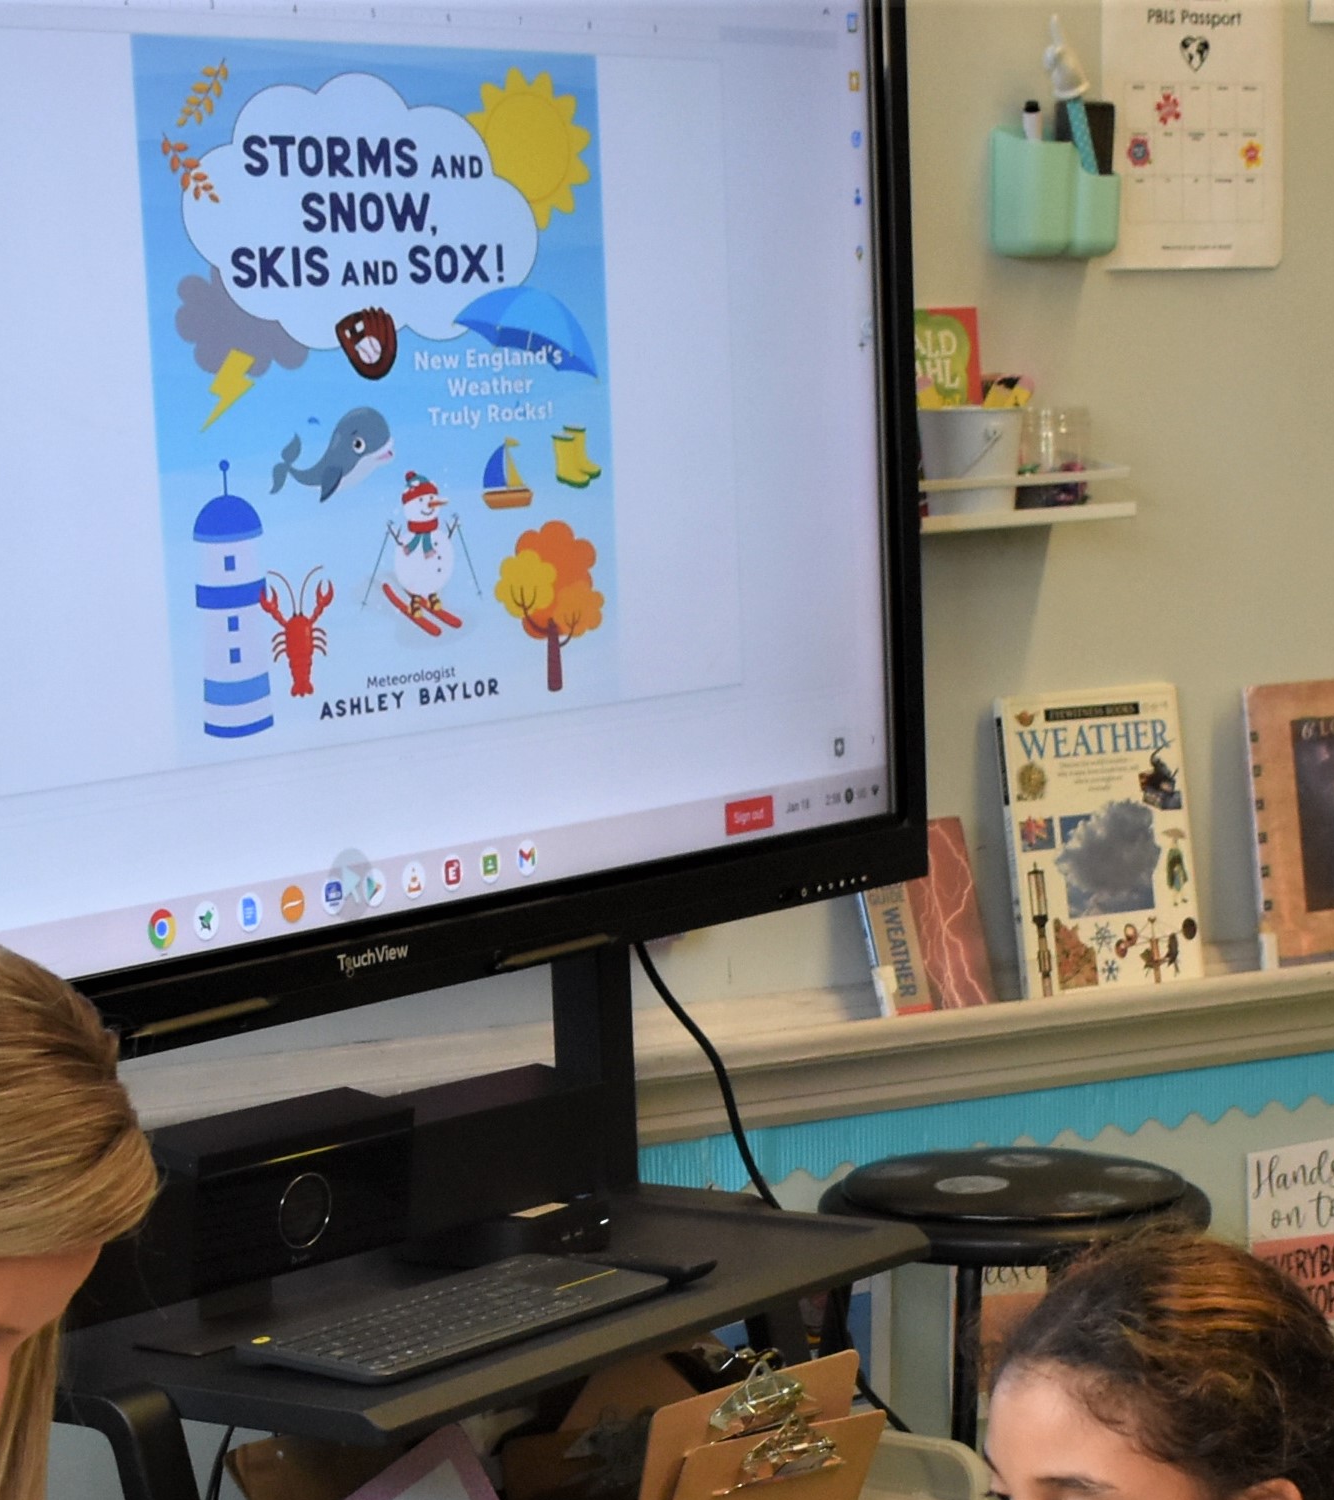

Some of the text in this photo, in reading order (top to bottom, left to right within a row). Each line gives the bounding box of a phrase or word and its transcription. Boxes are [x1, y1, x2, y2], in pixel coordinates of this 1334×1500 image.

[1147, 8, 1243, 29] PBIS Passport
[242, 135, 484, 179] STORMS AND
[301, 192, 439, 236] SNOW,
[230, 244, 505, 289] SKIS AND SOX!
[414, 345, 564, 373] New England's
[447, 376, 534, 398] Weather
[427, 402, 554, 430] Truly Rocks!
[366, 666, 456, 690] Meteorologist
[320, 678, 500, 721] ASHLEY BAYLOR
[1015, 719, 1171, 761] WEATHER
[751, 808, 765, 820] out
[336, 944, 409, 975] TouchView
[882, 906, 918, 998] WEATHER
[1270, 1206, 1308, 1230] on
